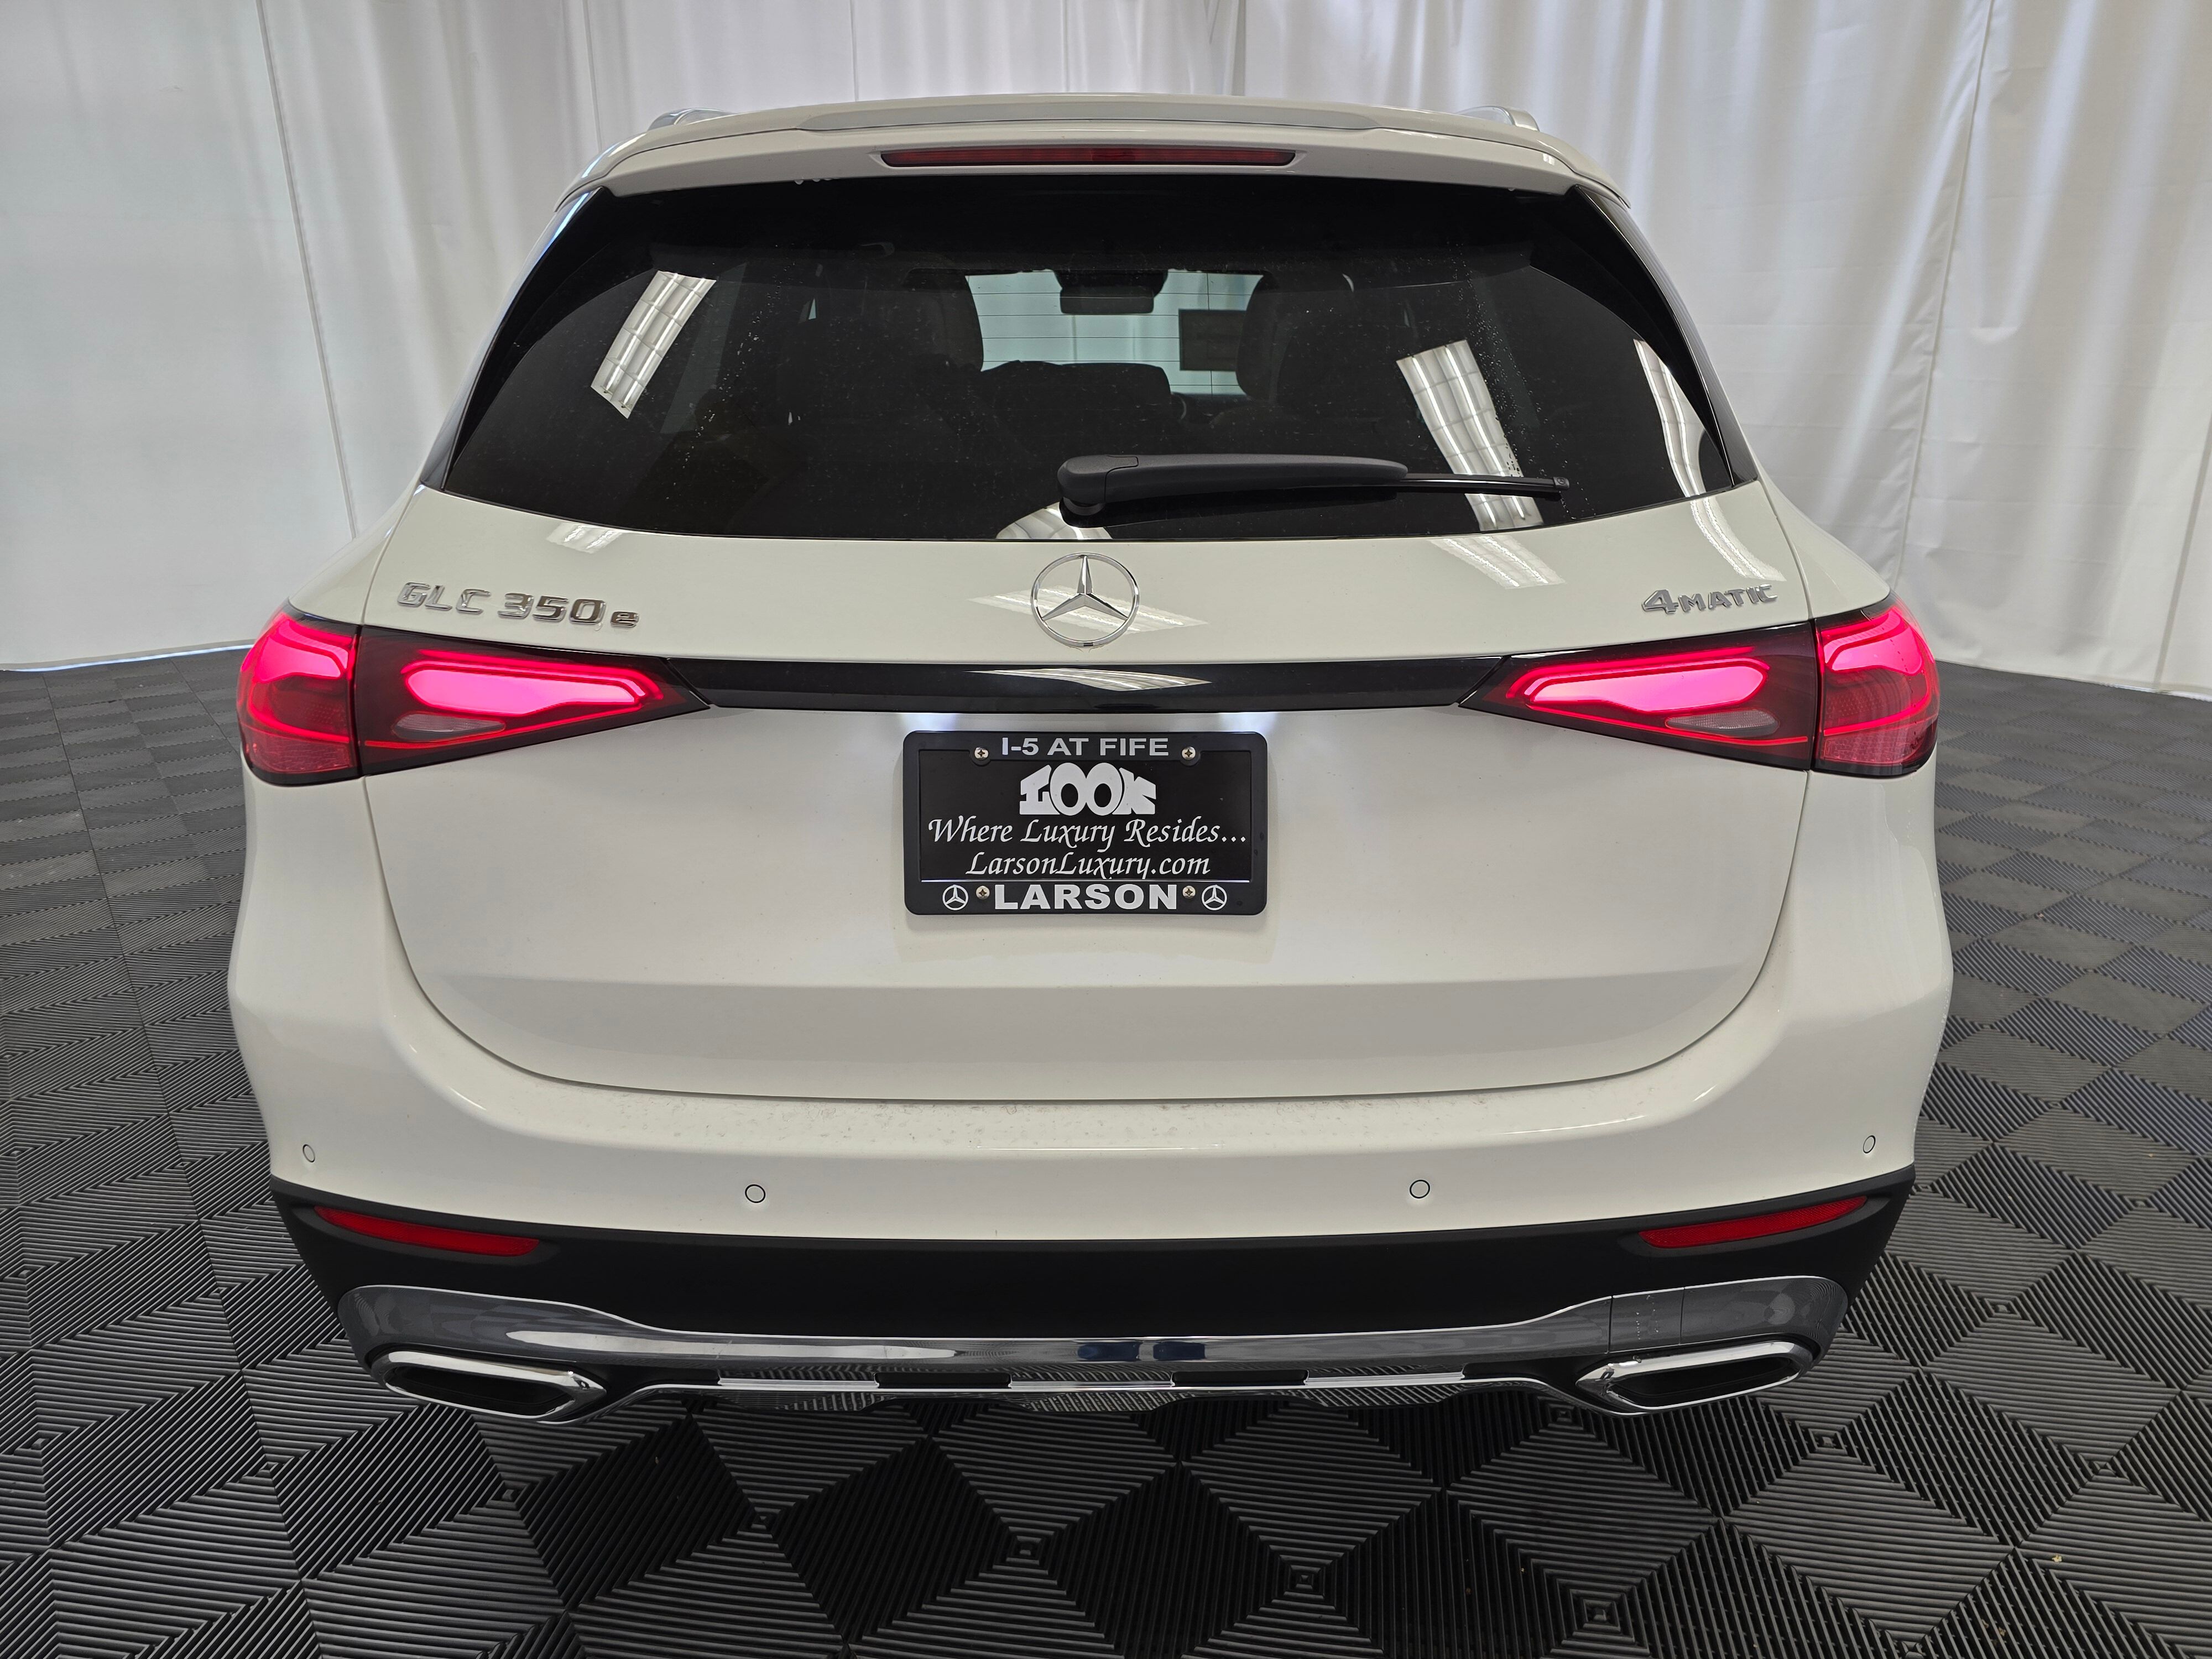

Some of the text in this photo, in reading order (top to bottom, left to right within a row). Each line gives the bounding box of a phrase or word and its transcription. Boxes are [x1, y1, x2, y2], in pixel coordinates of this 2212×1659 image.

[397, 582, 492, 614] GLC
[1641, 583, 1778, 614] 4MATIC
[1001, 738, 1169, 756] I-5 AT FIFE
[1019, 762, 1156, 816] LOOK
[928, 815, 1247, 853] Where Luxury Resides...
[966, 851, 1211, 880] LarsonLuxury.com
[995, 884, 1177, 910] LARSON
